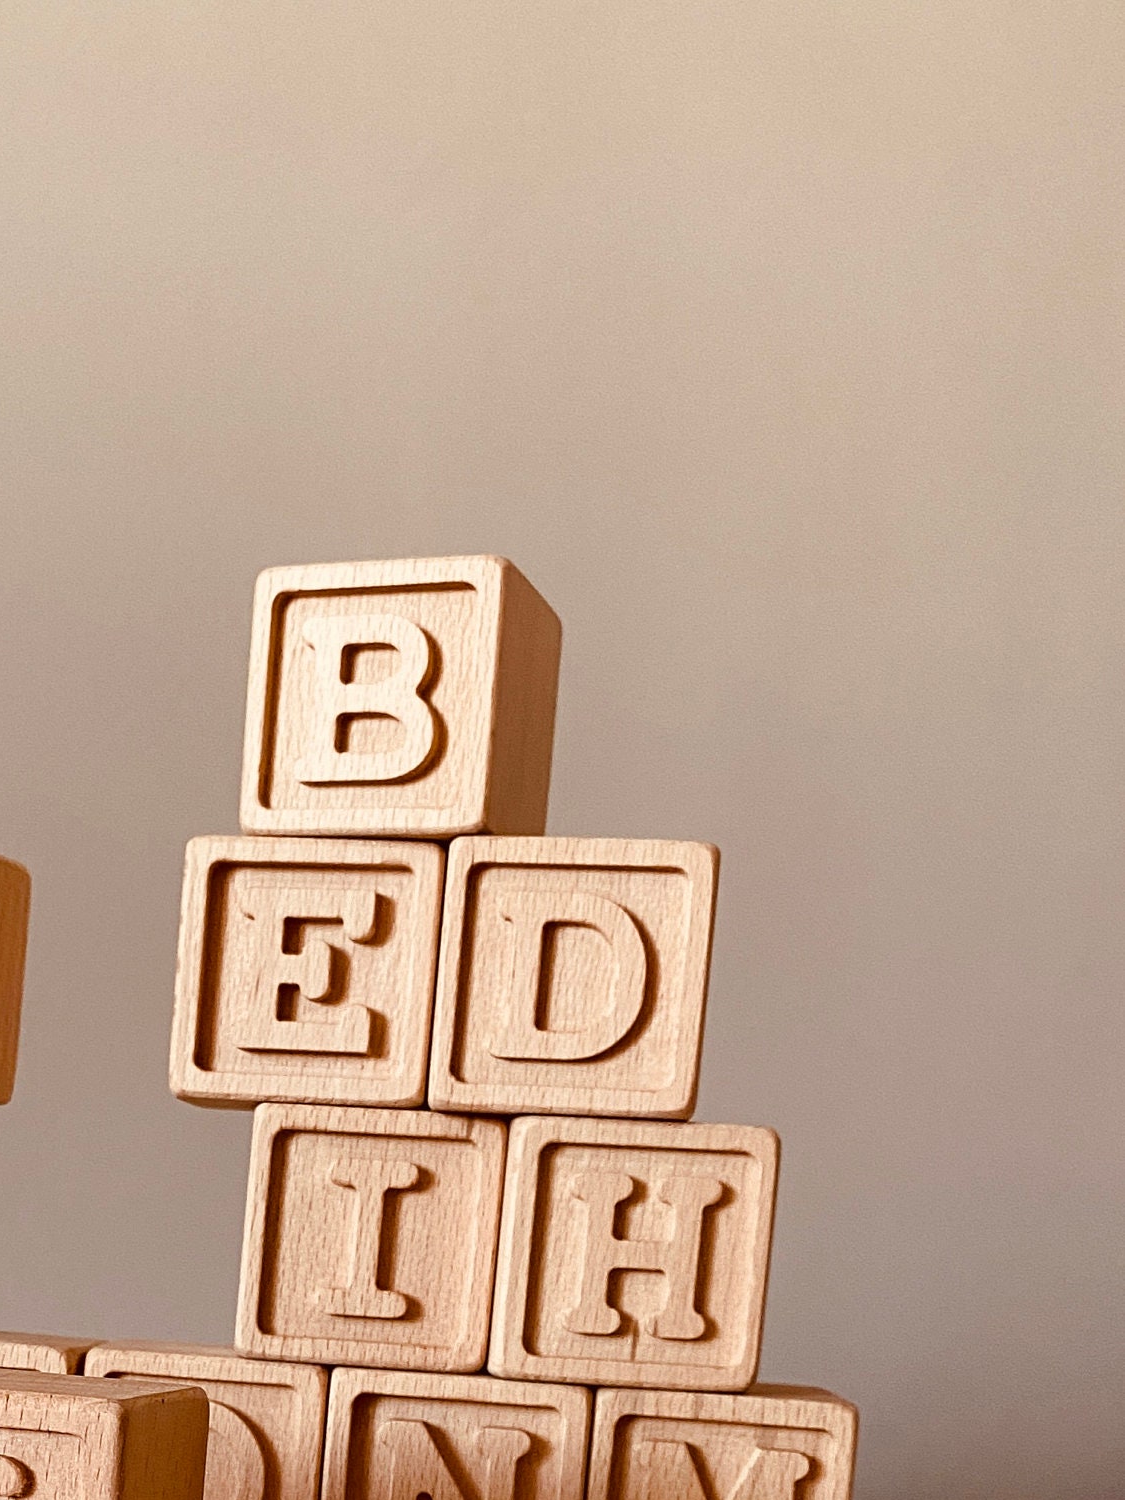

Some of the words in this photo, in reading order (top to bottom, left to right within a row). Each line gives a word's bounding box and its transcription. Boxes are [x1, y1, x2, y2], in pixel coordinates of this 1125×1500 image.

[294, 614, 443, 787] B
[234, 888, 379, 1057] E
[488, 890, 651, 1061] D
